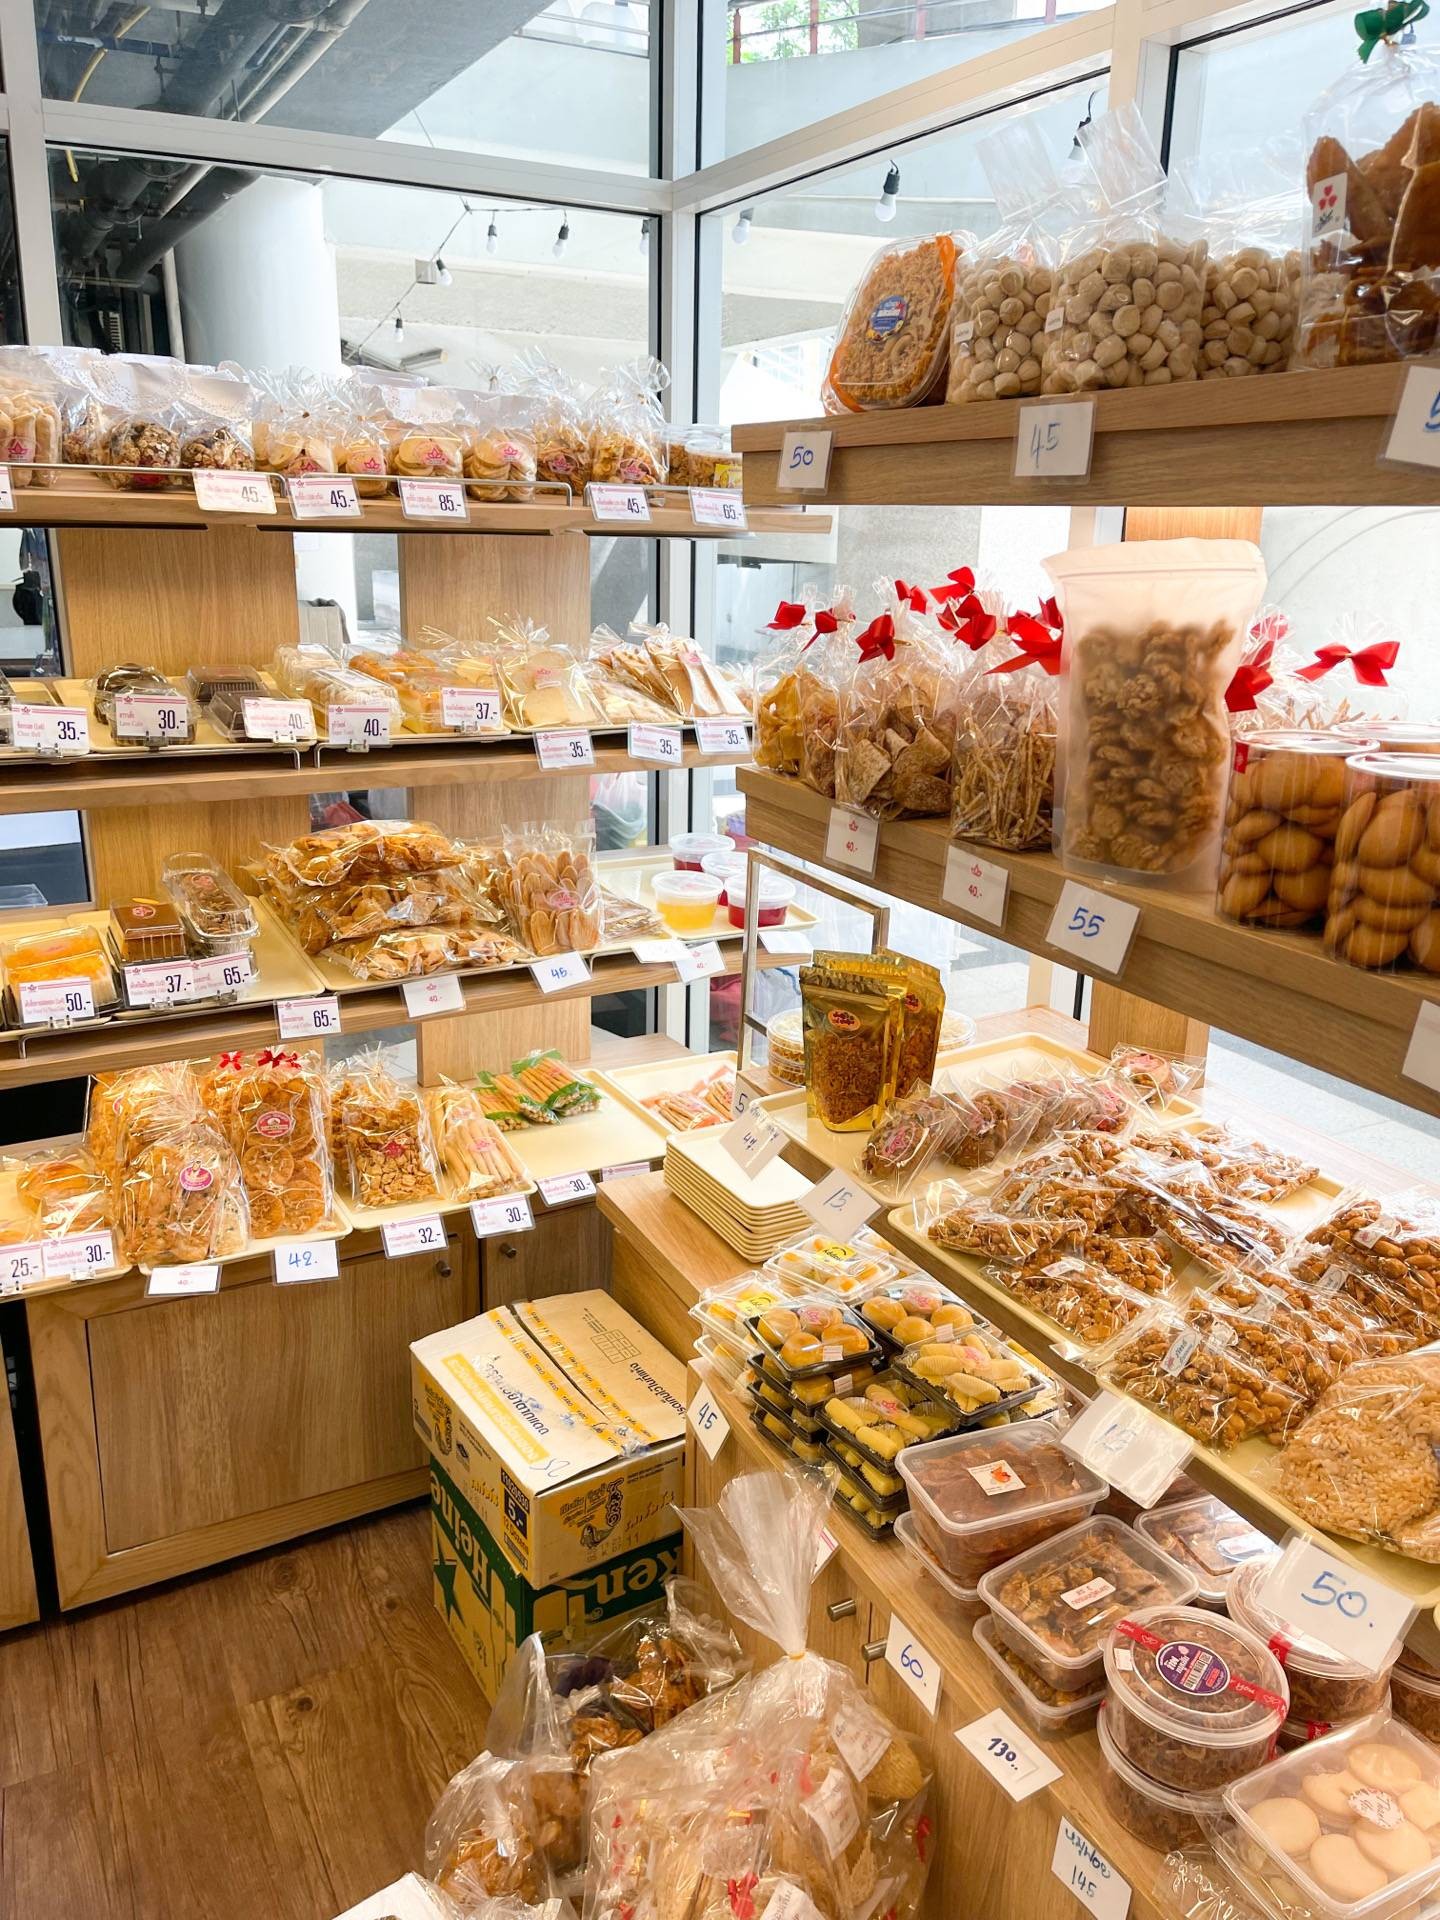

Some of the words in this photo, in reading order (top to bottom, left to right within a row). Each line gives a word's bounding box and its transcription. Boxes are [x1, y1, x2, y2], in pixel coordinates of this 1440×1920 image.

[1031, 423, 1060, 468] 45
[790, 446, 814, 469] 50
[330, 490, 356, 508] 45.-
[438, 494, 461, 512] 85.-
[157, 709, 185, 730] 30.-
[476, 703, 497, 720] 37.-
[57, 720, 86, 741] 35.-
[363, 718, 387, 737] 40.-
[570, 741, 589, 758] 35.-
[660, 738, 679, 755] 35.-
[1067, 906, 1105, 938] 55
[166, 974, 191, 993] 37.-
[223, 967, 249, 986] 65.-
[65, 992, 91, 1012] 50.-
[313, 1010, 337, 1028] 65.-
[570, 1178, 591, 1192] 30.-
[506, 1207, 528, 1223] 30.-
[419, 1226, 441, 1244] 32.-
[86, 1245, 111, 1263] 30.-
[11, 1258, 39, 1279] 25.-
[698, 1402, 718, 1430] 45
[1071, 1864, 1097, 1898] 145
